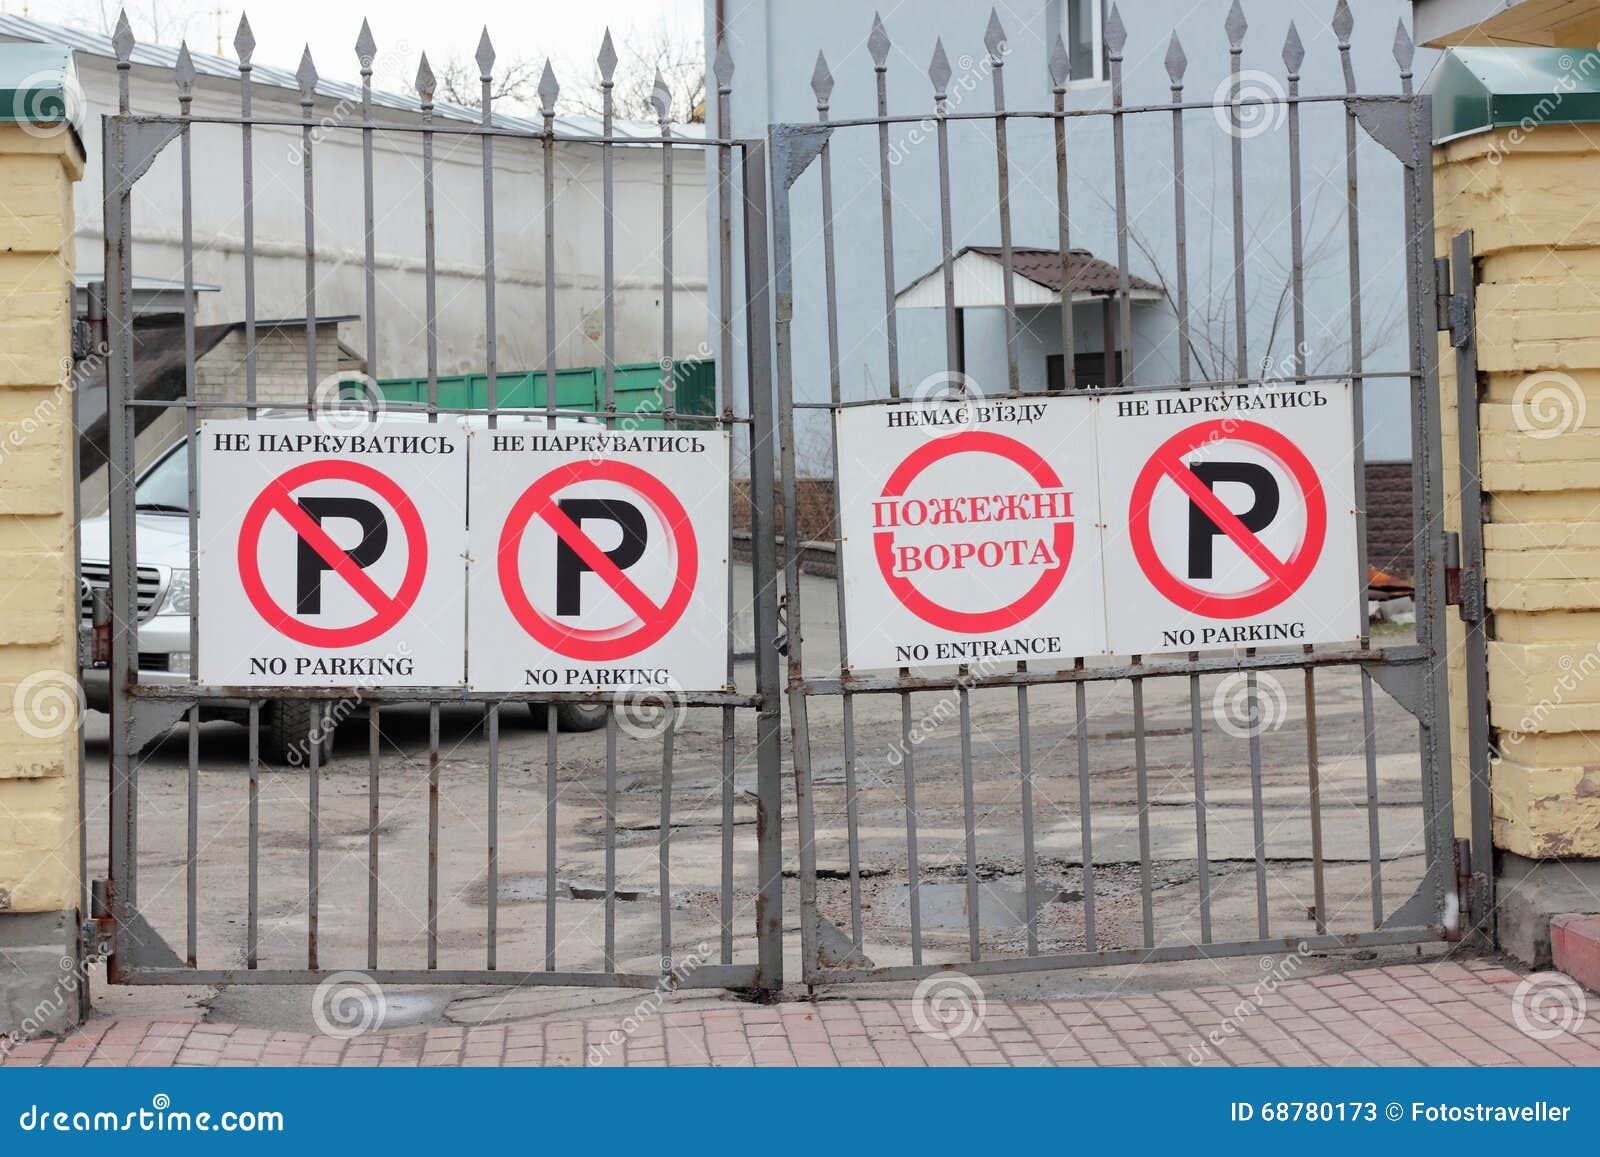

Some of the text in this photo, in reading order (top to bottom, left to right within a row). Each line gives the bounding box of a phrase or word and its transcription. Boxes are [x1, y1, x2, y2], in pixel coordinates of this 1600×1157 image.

[887, 402, 1048, 428] НЕМАЄ В'ЇЗДУ
[1117, 390, 1328, 417] НЕ ПАРКУВАТИСЬ
[213, 433, 455, 455] НЕ ПАРКУВАТИСЬ
[492, 435, 706, 453] НЕ ПАРКУВАТИСЬ
[871, 491, 1075, 528] ПОЖЕЖНІ
[896, 538, 1055, 572] ВОРОТА
[1162, 622, 1305, 647] NO PARKING
[895, 636, 1061, 662] NO ENTRANCE
[249, 657, 414, 676] NO PARKING
[525, 668, 669, 686] NO PARKING
